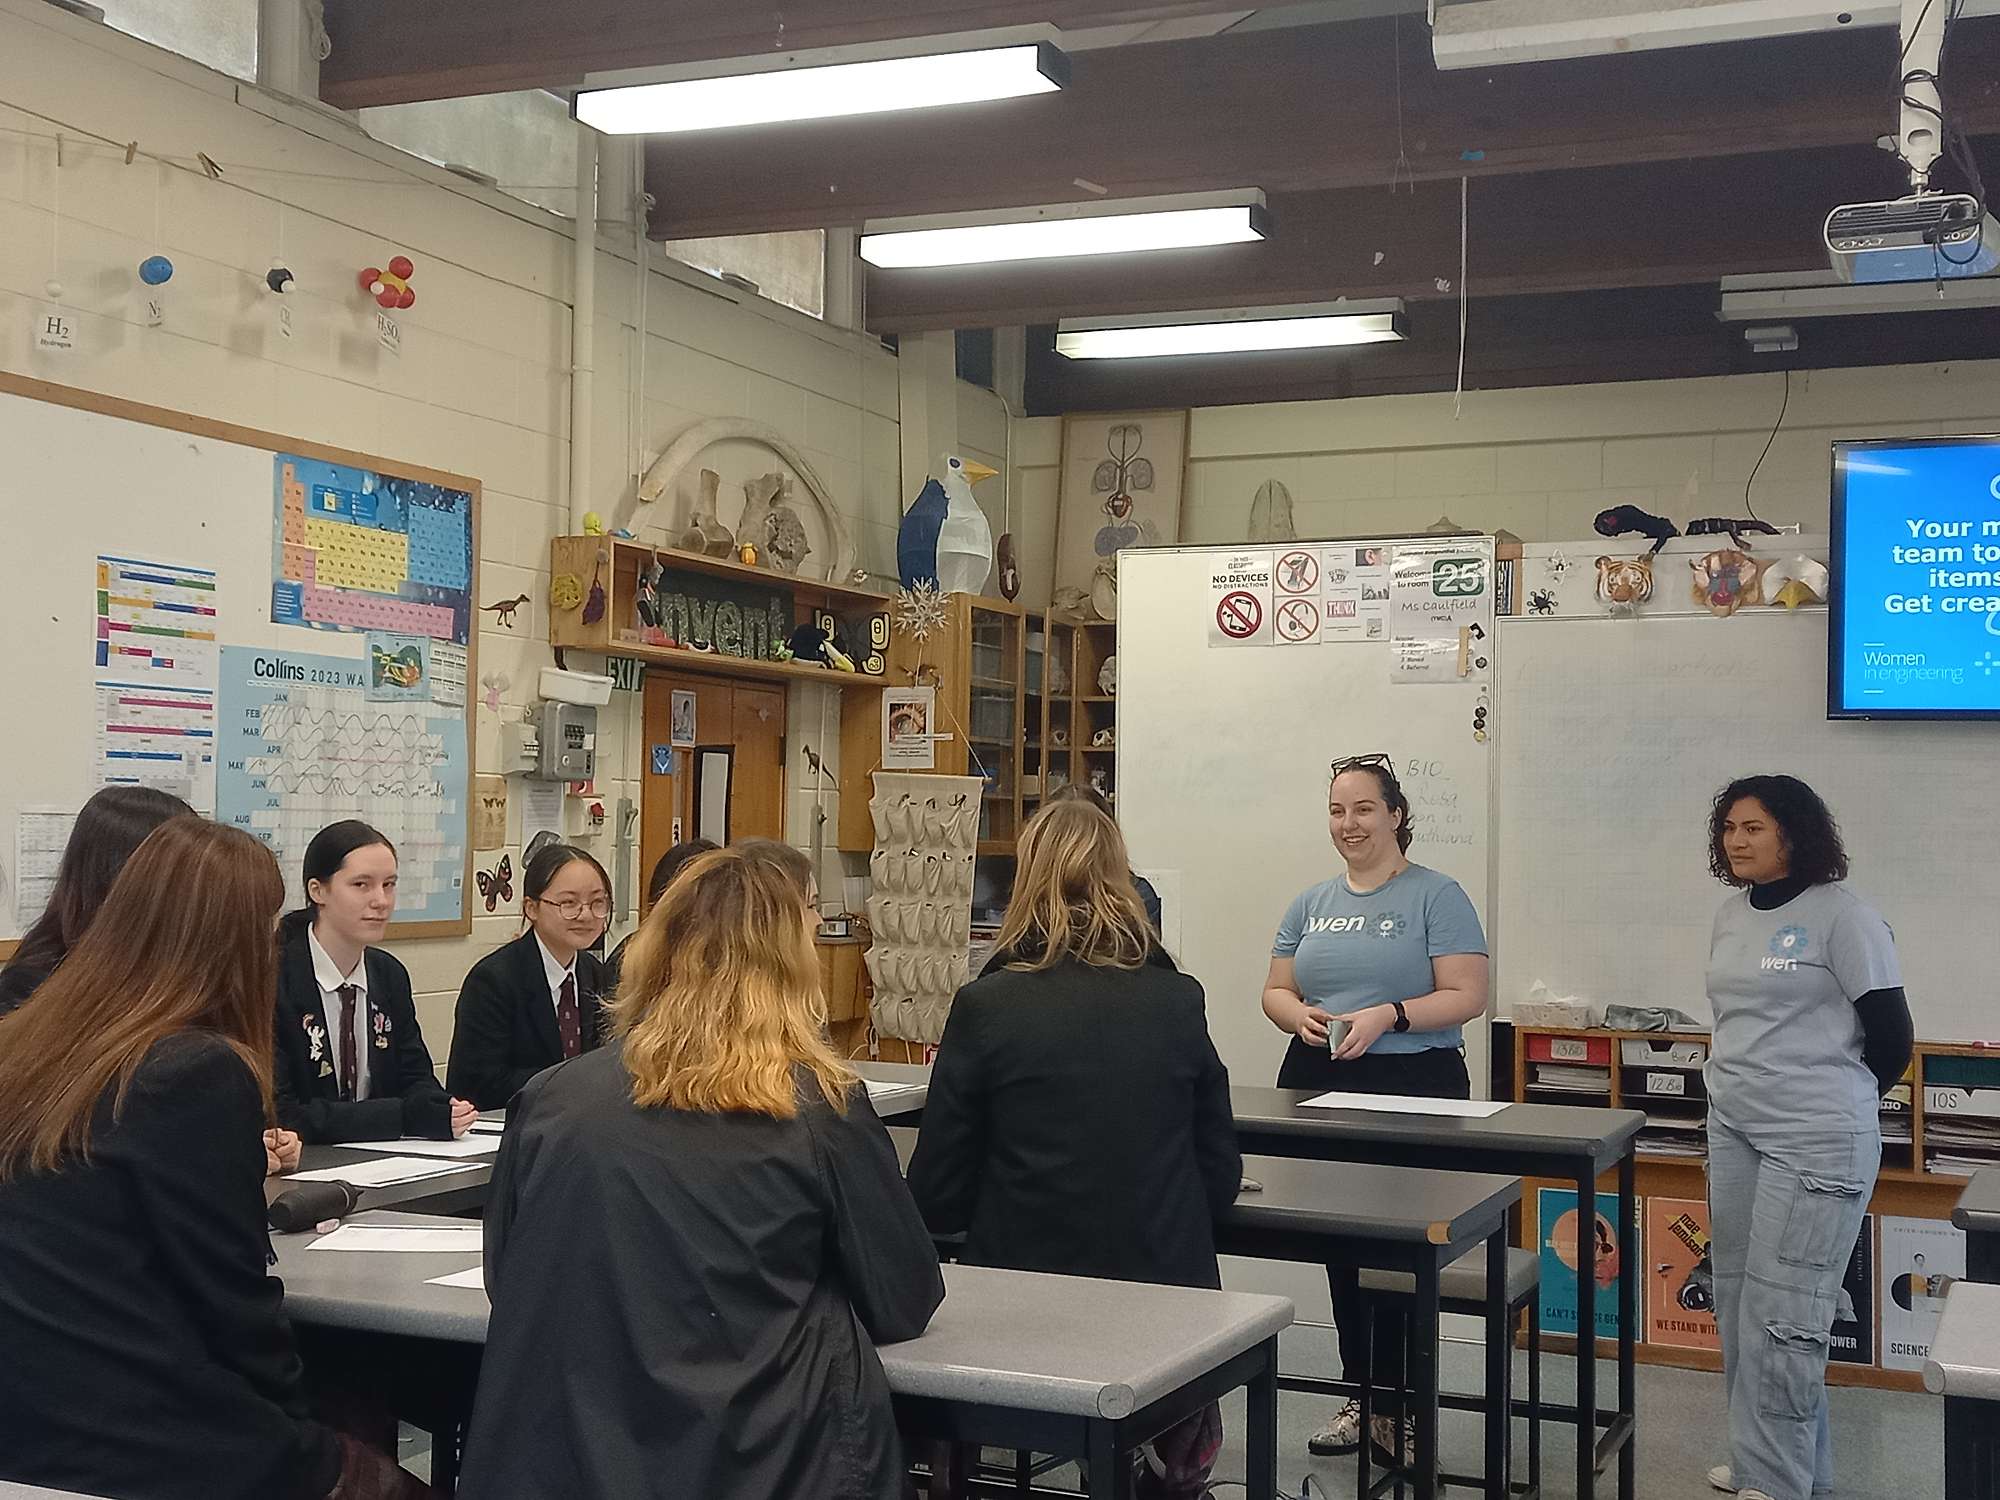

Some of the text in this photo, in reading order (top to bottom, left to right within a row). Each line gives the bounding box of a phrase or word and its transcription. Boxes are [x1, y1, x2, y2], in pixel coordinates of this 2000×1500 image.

[40, 338, 72, 349] Hydrogen
[1906, 519, 2000, 538] Your m
[1893, 545, 1963, 564] team
[1212, 573, 1269, 584] NO DEVICES
[1438, 563, 1481, 593] 25
[1929, 568, 2000, 588] items
[1401, 600, 1478, 612] Ms Caulfield
[1884, 595, 2000, 613] Get crea
[1864, 651, 1926, 666] Women
[253, 657, 365, 687] Collins 2023 WA
[607, 657, 646, 691] EXIT
[1879, 666, 1964, 684] engineering
[274, 693, 288, 702] JAN
[245, 709, 260, 719] FEB
[242, 727, 260, 737] MAR
[267, 745, 281, 754] APR
[228, 761, 244, 770] MAY
[252, 780, 267, 789] JUN
[267, 799, 279, 807] JUL
[234, 815, 250, 824] AUG
[1309, 914, 1366, 932] wen
[1761, 957, 1797, 971] wen
[1688, 1052, 1699, 1063] F
[1651, 1077, 1664, 1091] 12
[1679, 1213, 1701, 1235] mae
[1656, 1319, 1668, 1331] WE
[1670, 1320, 1698, 1334] STAND
[1830, 1335, 1857, 1349] OWER
[1891, 1342, 1929, 1357] SCIENCE
